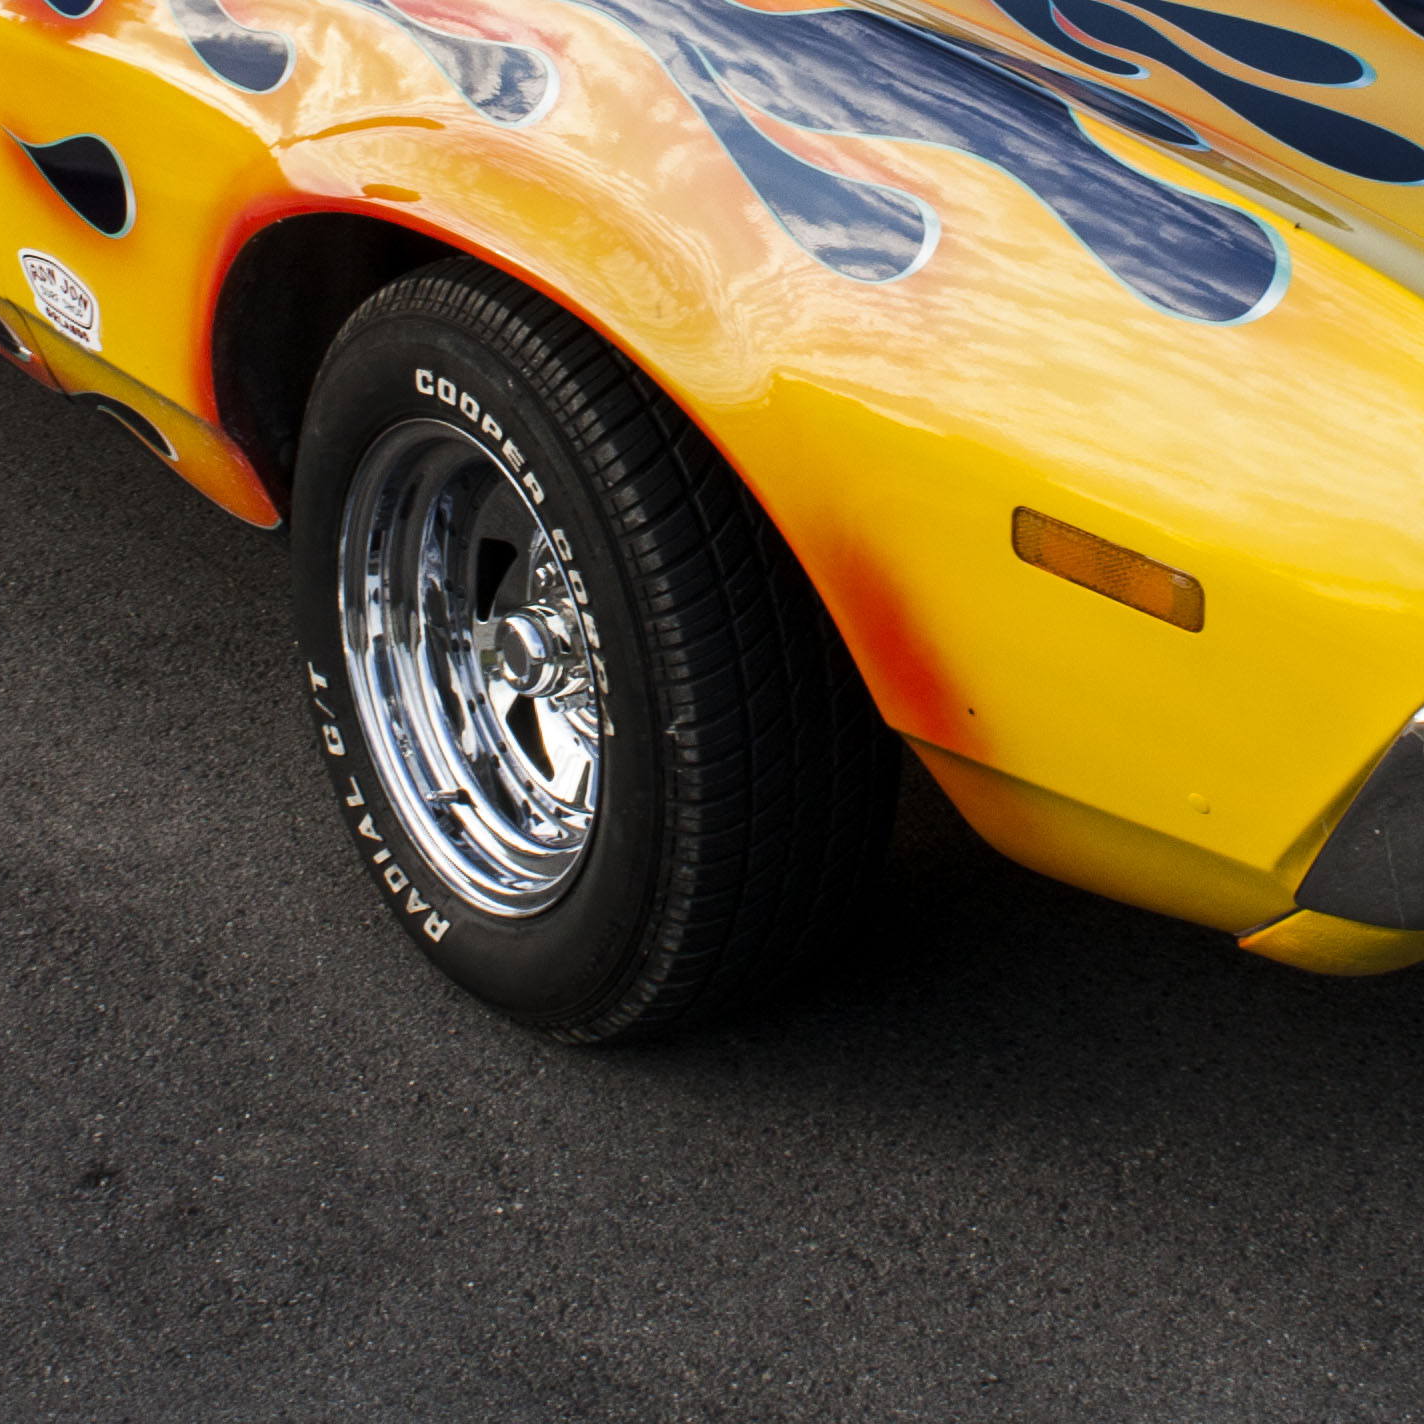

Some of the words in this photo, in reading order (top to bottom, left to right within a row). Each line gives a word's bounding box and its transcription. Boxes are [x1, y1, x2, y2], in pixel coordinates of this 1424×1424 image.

[415, 368, 546, 505] COOPER
[307, 661, 346, 756] G/T
[346, 776, 450, 943] RADIAL
